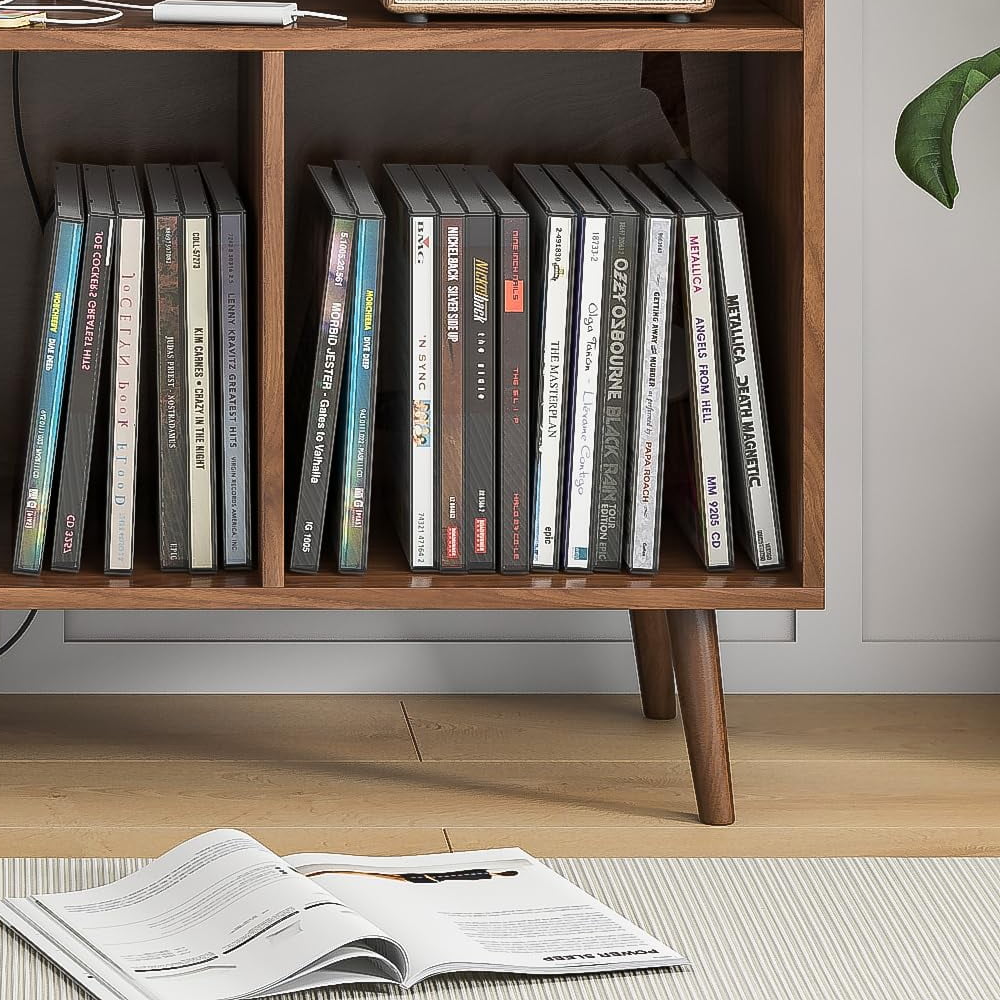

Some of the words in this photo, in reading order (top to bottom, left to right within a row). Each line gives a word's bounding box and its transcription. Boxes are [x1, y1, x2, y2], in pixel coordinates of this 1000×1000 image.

[448, 226, 458, 281] NICKELBACK
[690, 236, 703, 293] METALLICA
[611, 258, 629, 306] OZZY
[364, 289, 374, 330] MORCHEEBA
[448, 285, 458, 312] SILVER
[652, 291, 661, 322] GETTING
[327, 302, 341, 345] MORBID
[448, 314, 458, 330] SIDE
[584, 303, 599, 332] Olga
[194, 327, 204, 343] KIM
[363, 336, 371, 352] DIVE
[448, 332, 459, 343] UP
[651, 323, 659, 344] AWAY
[696, 317, 707, 358] ANGELS
[165, 336, 175, 358] JUDAS
[228, 329, 236, 369] KRAVITZ
[550, 340, 560, 362] THE
[607, 305, 627, 400] OSBOURNE
[167, 361, 175, 387] PRIEST
[194, 346, 204, 377] CARNES
[322, 347, 336, 389] JESTER
[362, 353, 370, 369] DEEP
[648, 356, 657, 387] MURDER
[699, 364, 710, 394] FROM
[726, 294, 748, 364] METALLICA
[741, 421, 762, 487] MAGNETIC
[195, 388, 204, 414] CRAZY
[229, 374, 237, 422] GREATEST
[547, 364, 559, 438] MASTERPLAN
[168, 395, 177, 448] NOSTRADAMUS
[195, 416, 204, 424] IN
[317, 399, 330, 428] Gates
[701, 400, 713, 423] HELL
[196, 427, 205, 442] THE
[316, 431, 326, 441] to
[604, 406, 622, 459] BLACK
[196, 445, 205, 469] NIGHT
[311, 444, 325, 483] Valhalla
[644, 441, 653, 466] PAPA
[575, 445, 591, 495] Contigo
[602, 463, 620, 501] RAIN
[642, 469, 651, 502] ROACH
[707, 476, 718, 495] MM
[305, 521, 313, 530] IG
[600, 503, 609, 539] EDITION
[608, 504, 617, 528] TOUR
[709, 501, 720, 526] 9205
[302, 533, 312, 552] 1005
[543, 526, 553, 544] epic
[711, 532, 722, 548] CD
[170, 543, 178, 560] EPIC
[599, 541, 607, 560] EPIC
[542, 953, 595, 961] SLEEP
[597, 948, 660, 957] POWER
